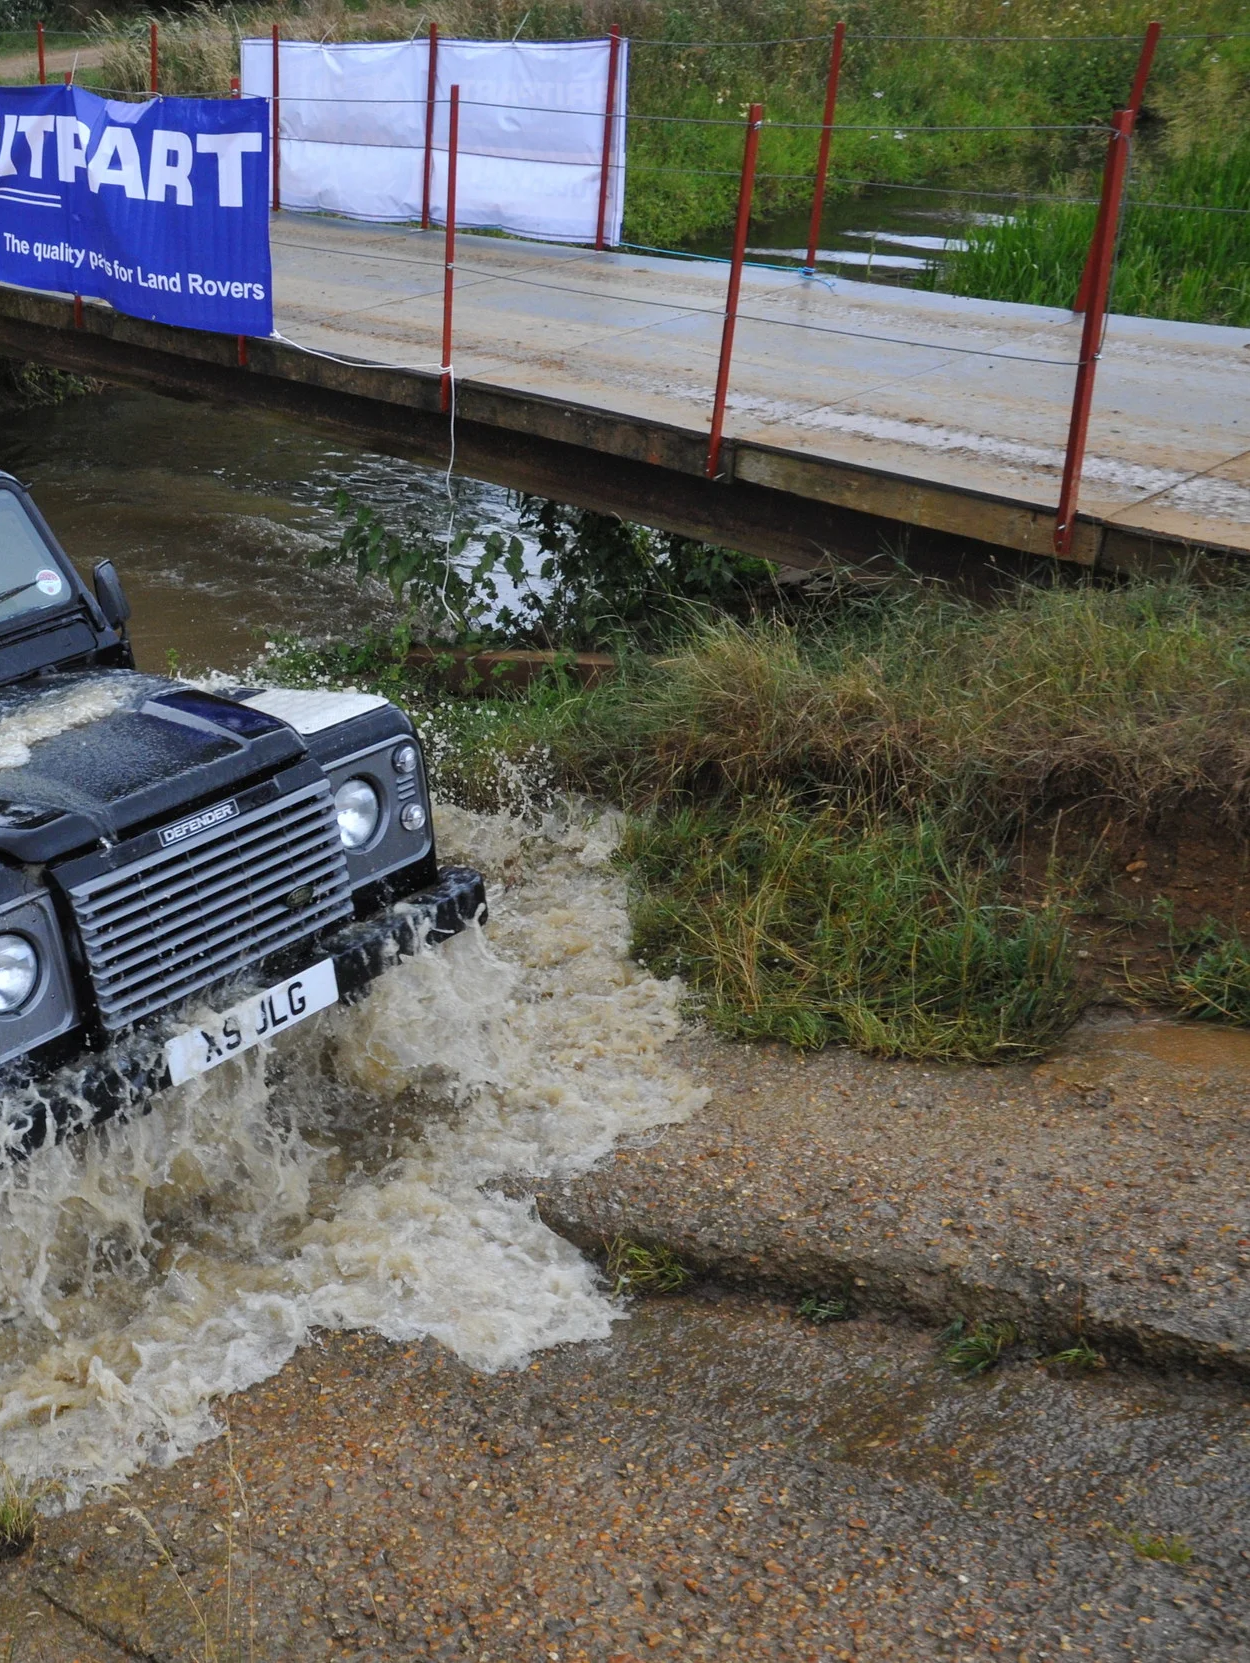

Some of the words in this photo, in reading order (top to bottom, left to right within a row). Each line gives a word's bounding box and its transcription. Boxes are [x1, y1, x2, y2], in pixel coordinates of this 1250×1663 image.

[3, 232, 30, 255] The
[33, 242, 86, 269] quality
[113, 260, 134, 283] for
[137, 266, 181, 293] Land
[187, 273, 266, 301] Rovers
[163, 804, 234, 842] DEFENDER
[256, 981, 306, 1036] JLG
